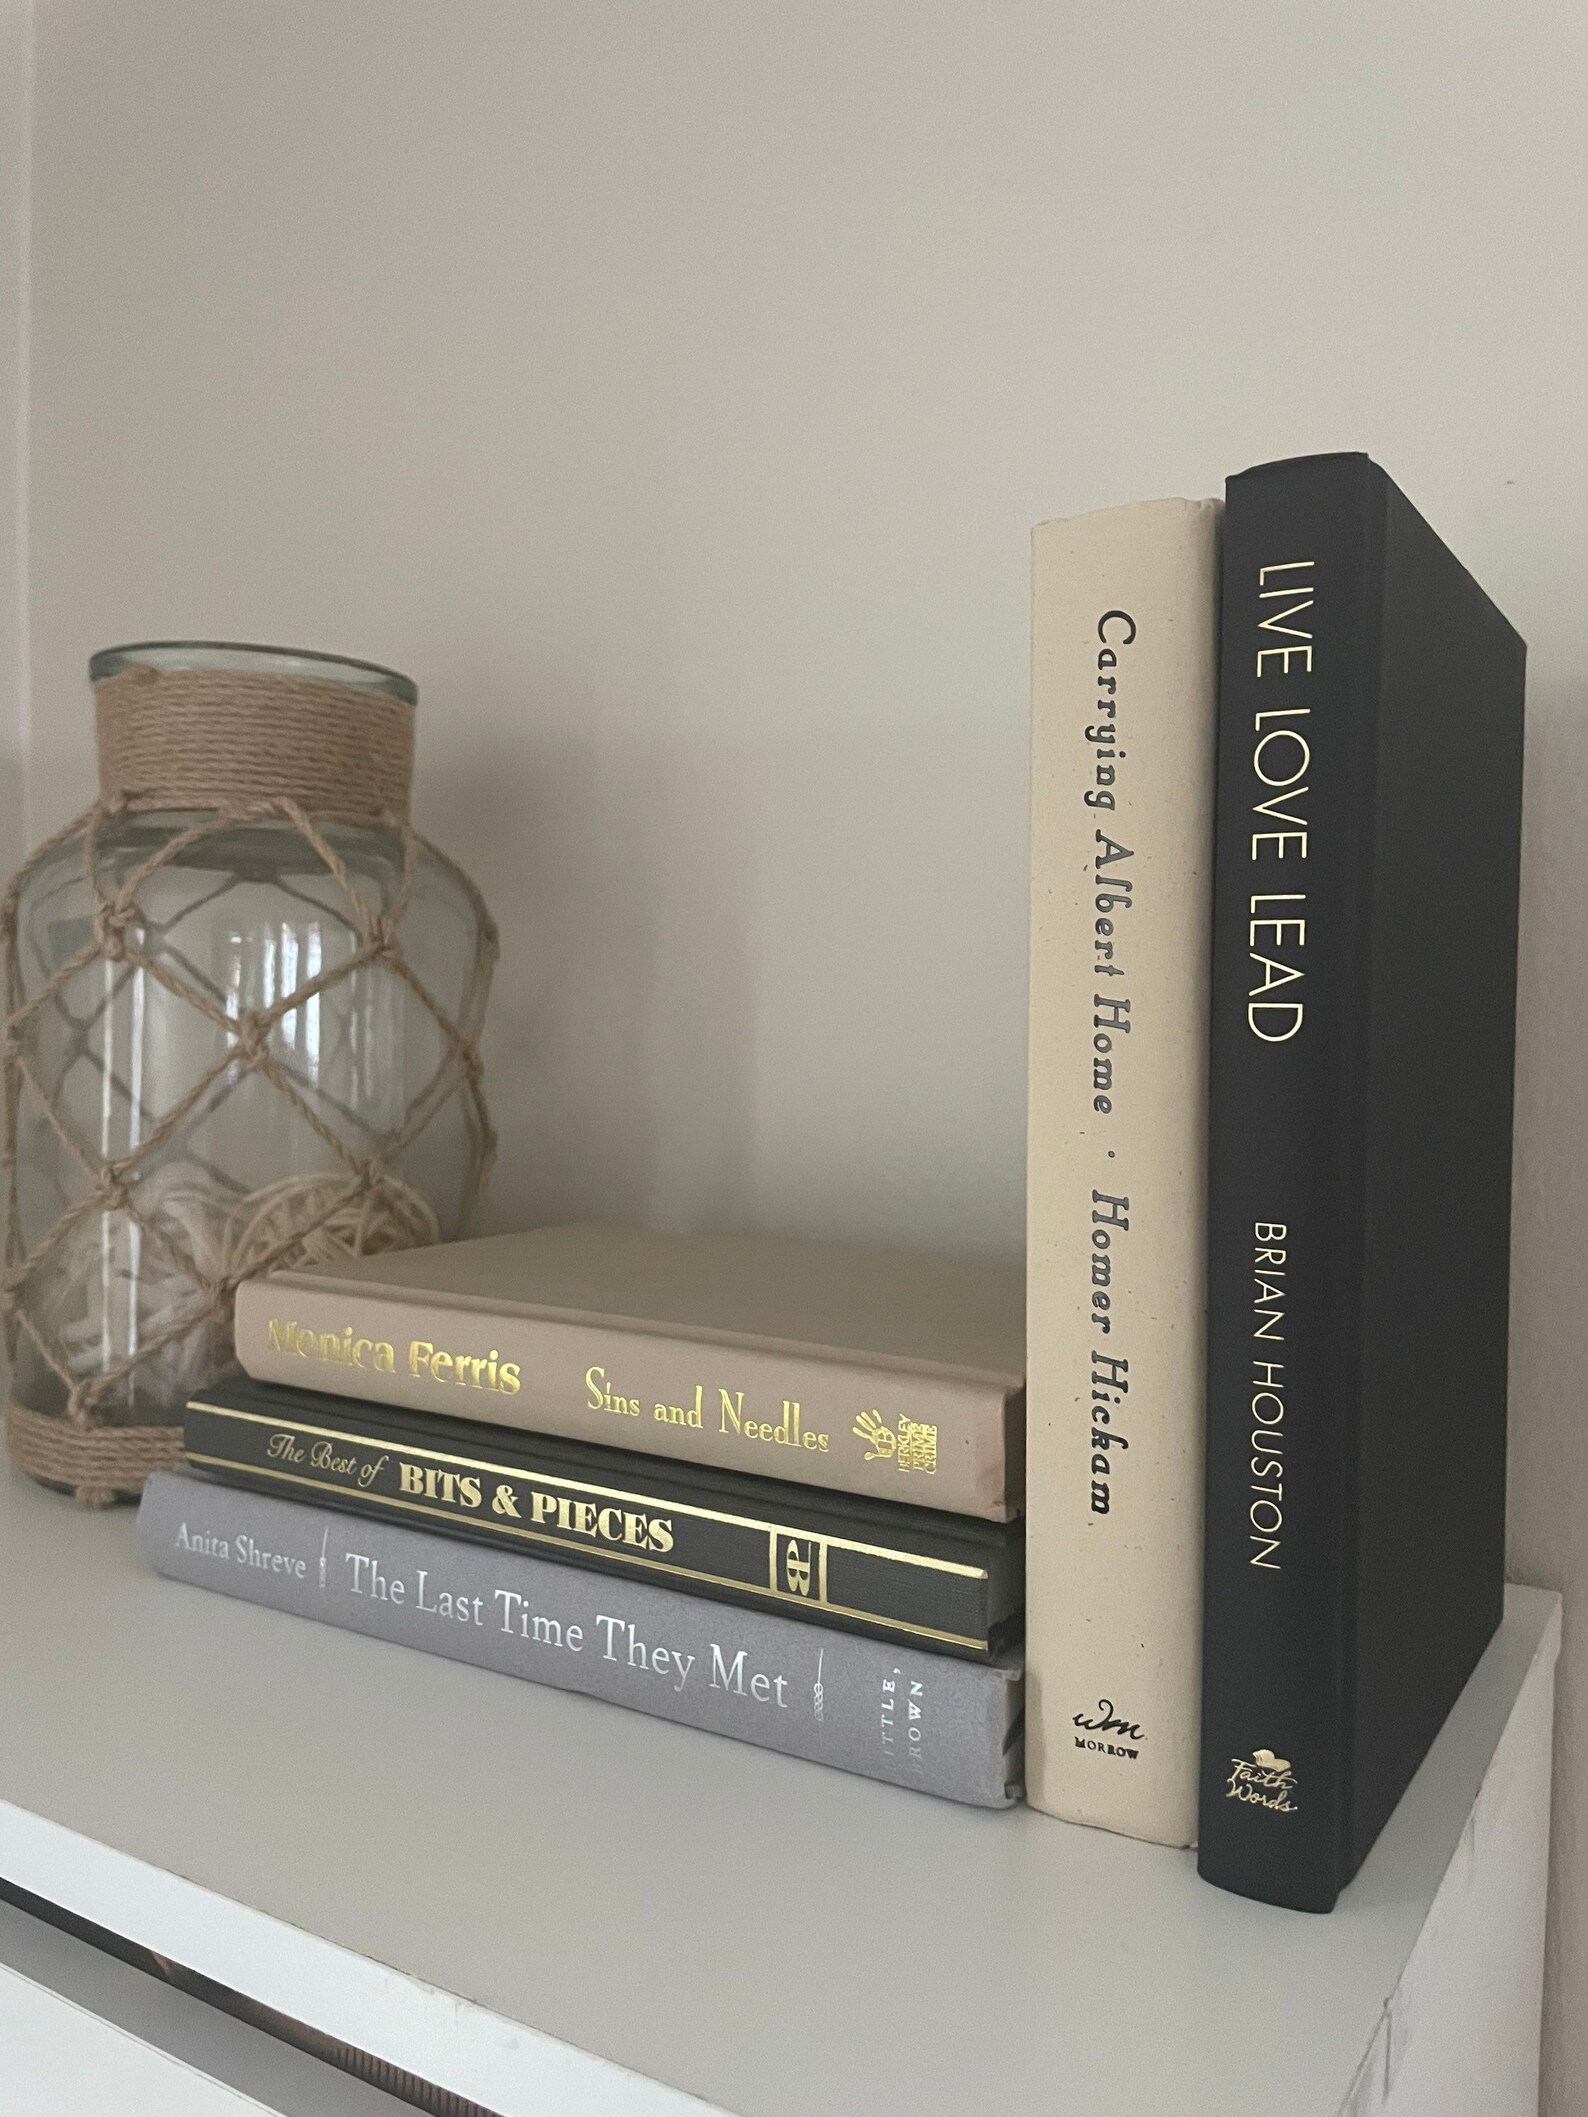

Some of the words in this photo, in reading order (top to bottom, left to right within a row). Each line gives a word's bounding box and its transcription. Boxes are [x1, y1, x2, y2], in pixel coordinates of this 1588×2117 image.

[1257, 561, 1315, 678] LIVE
[1084, 610, 1137, 811] Carrying
[1251, 708, 1311, 862] LOVE
[1094, 828, 1135, 977] Albert
[1247, 894, 1306, 1043] LEAD
[1093, 993, 1132, 1116] Home
[1091, 1188, 1130, 1335] Homer
[1253, 1221, 1287, 1341] BRIAN
[267, 1318, 397, 1374] Monica
[408, 1340, 522, 1396] Ferris
[584, 1366, 640, 1417] Sins
[653, 1384, 704, 1430] and
[718, 1388, 829, 1453] Needles
[911, 1421, 924, 1471] PRIME
[923, 1424, 938, 1475] CRIME
[1091, 1350, 1130, 1515] Hickam
[1249, 1360, 1285, 1570] HOUSTON
[175, 1522, 230, 1559] Anita
[234, 1534, 307, 1580] Shreve
[266, 1433, 305, 1464] The
[310, 1441, 358, 1476] Best
[357, 1454, 390, 1488] of
[399, 1461, 482, 1508] BITS
[491, 1485, 521, 1519] &
[529, 1492, 675, 1553] PIECES
[344, 1551, 406, 1605] The
[415, 1569, 484, 1627] Last
[493, 1588, 584, 1652] Time
[595, 1614, 696, 1692] They
[709, 1643, 789, 1709] Met
[881, 1667, 902, 1771] ITTLE,
[1074, 1736, 1140, 1760] MORROW
[1228, 1757, 1298, 1790] Faith
[1225, 1778, 1299, 1813] Words
